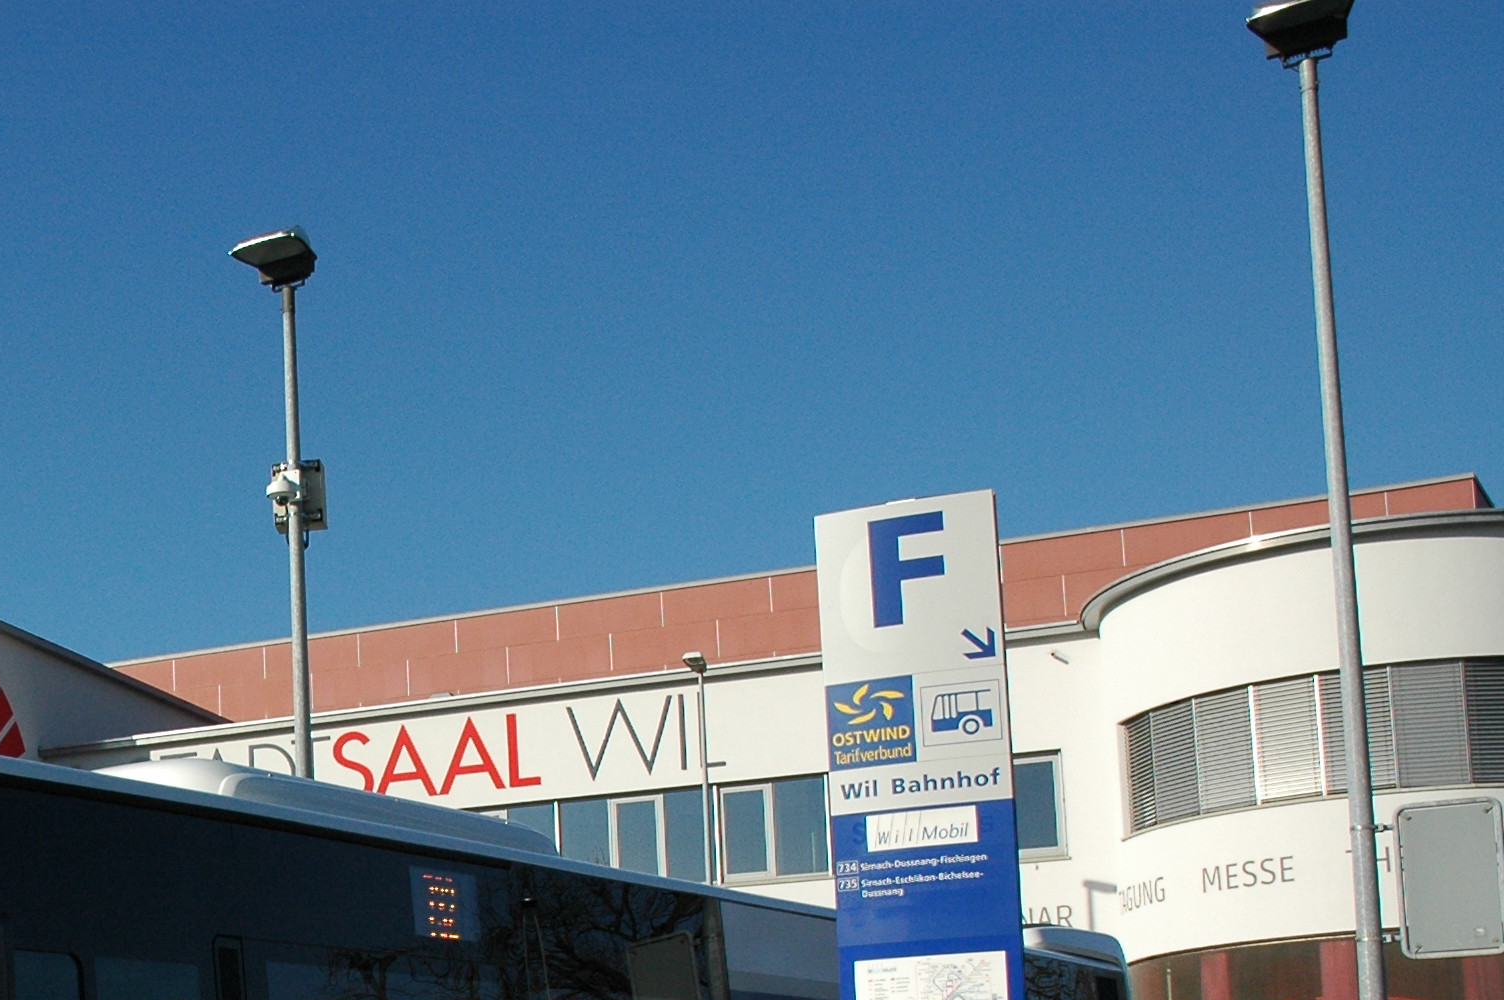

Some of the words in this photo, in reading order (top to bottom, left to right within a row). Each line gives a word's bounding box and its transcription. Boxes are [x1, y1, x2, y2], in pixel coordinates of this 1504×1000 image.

[867, 511, 945, 629] F
[566, 691, 727, 782] WIL
[832, 725, 911, 746] OSTWIND
[834, 743, 913, 765] Tarifverbund
[841, 780, 878, 800] Wil
[891, 767, 1000, 795] Bahnhof
[921, 822, 969, 840] Mobil
[838, 863, 858, 873] 734
[1201, 855, 1295, 893] MESSE
[838, 878, 858, 889] 735
